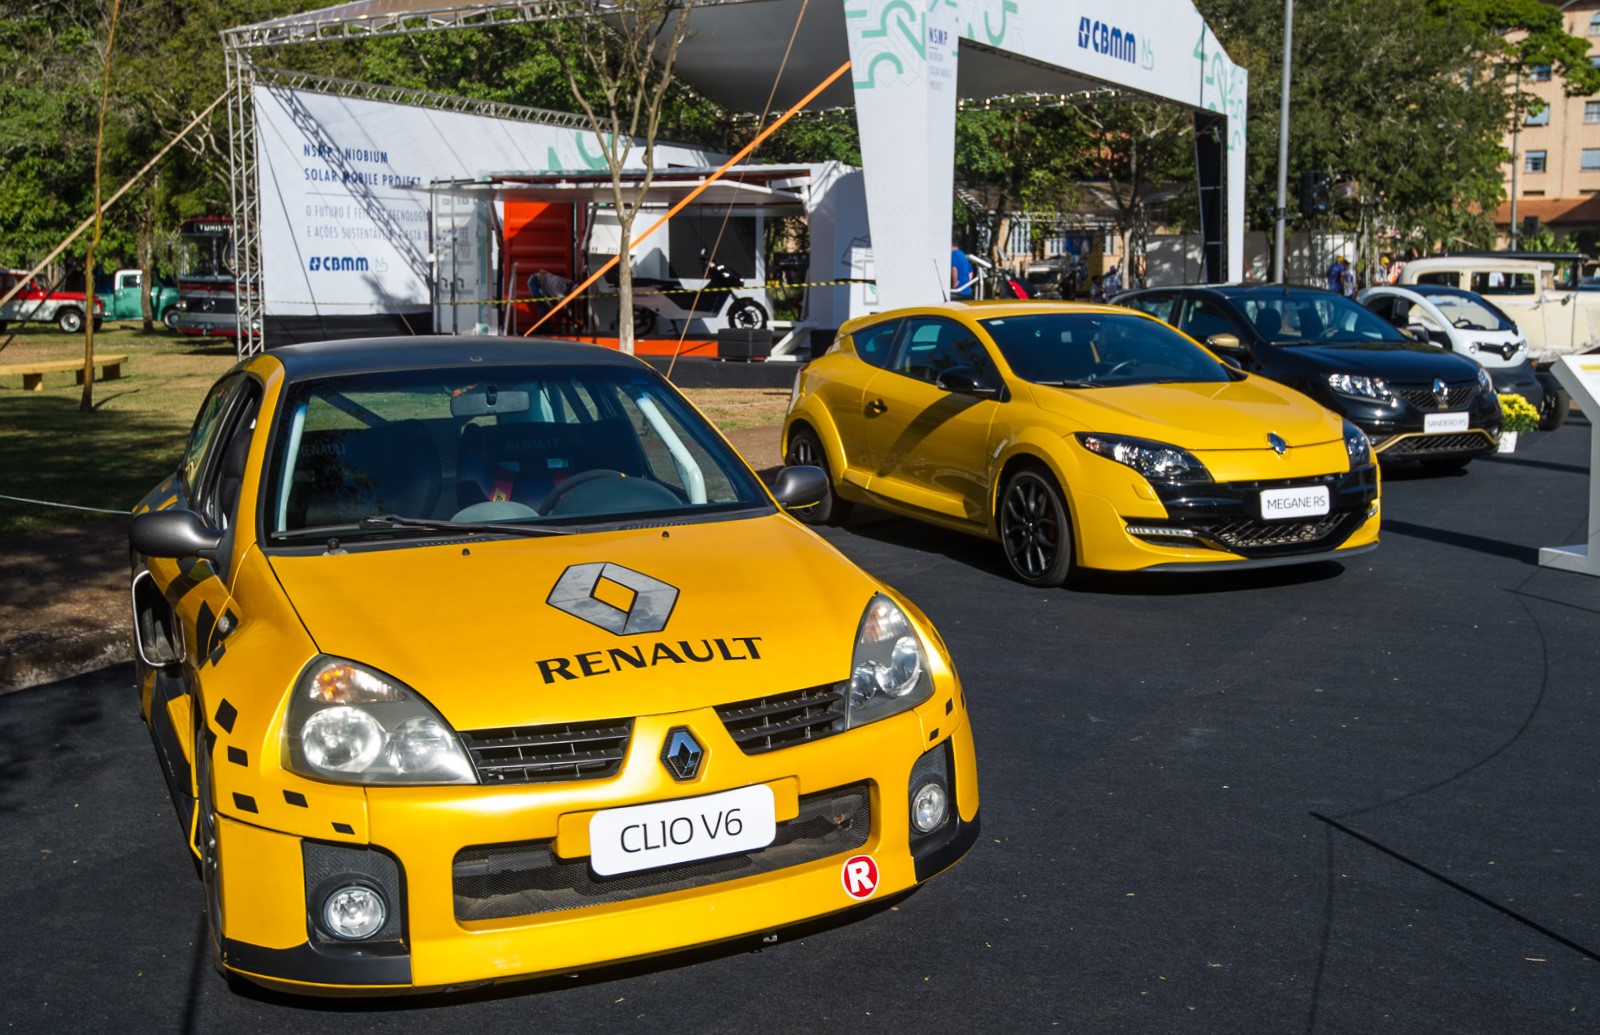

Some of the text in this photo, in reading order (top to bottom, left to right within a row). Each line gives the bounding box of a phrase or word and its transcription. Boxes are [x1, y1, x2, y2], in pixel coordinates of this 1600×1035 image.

[928, 27, 948, 46] NSMP
[1092, 20, 1136, 64] CBMM
[345, 148, 389, 164] NIOBIUM
[304, 168, 337, 182] SOLAR
[342, 171, 379, 186] MOBILE
[315, 205, 344, 218] FUTURO
[314, 225, 339, 241] AÇÕES
[323, 256, 370, 272] CBMM
[1267, 495, 1326, 510] MEGANE RS
[535, 636, 763, 685] RENAULT
[620, 808, 744, 853] CLIO V6
[847, 860, 875, 894] R
